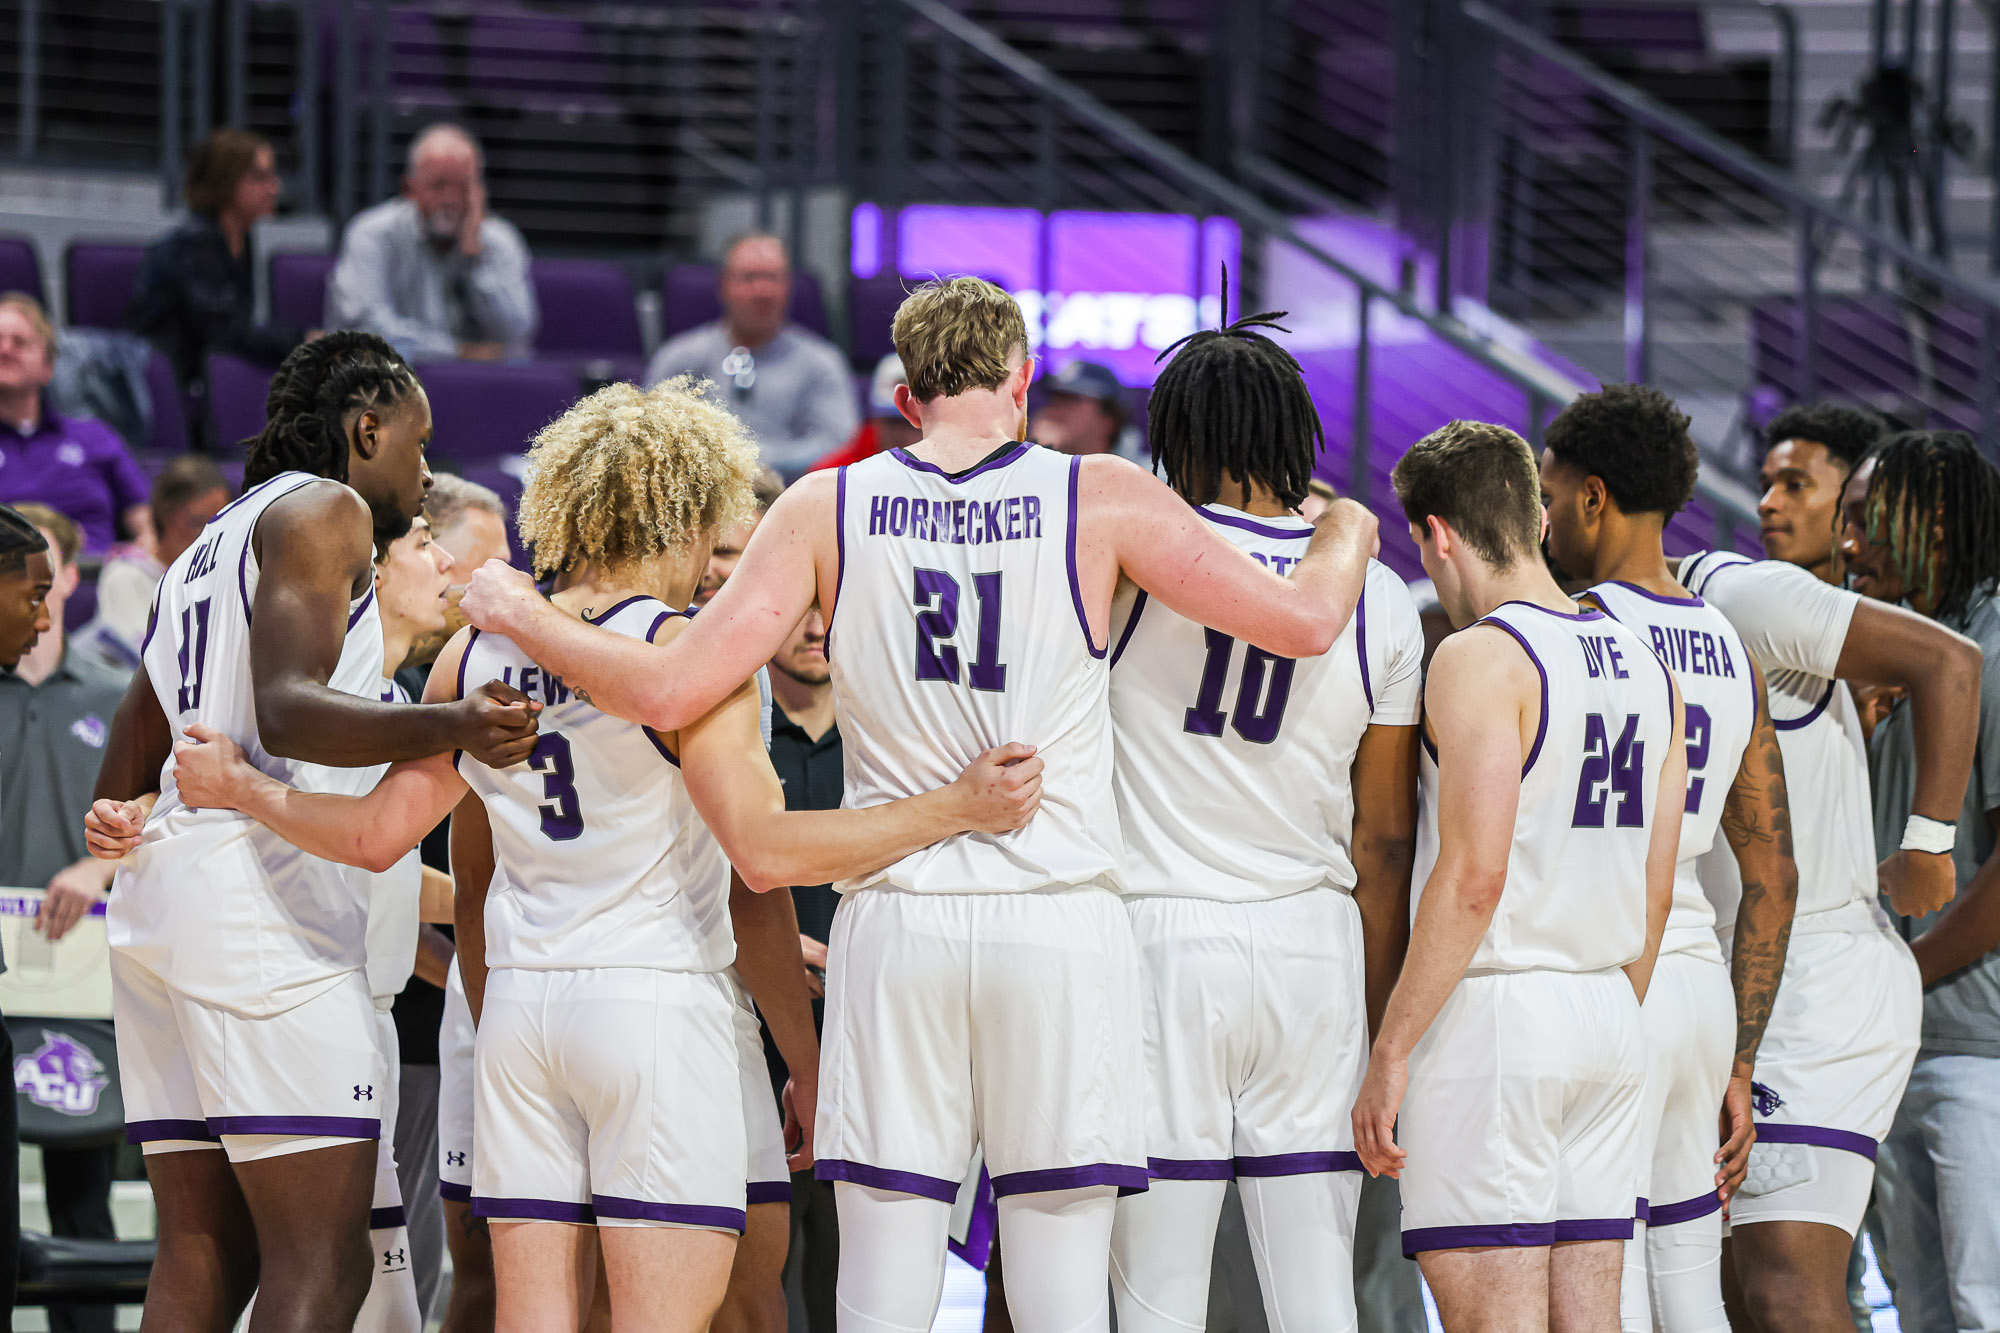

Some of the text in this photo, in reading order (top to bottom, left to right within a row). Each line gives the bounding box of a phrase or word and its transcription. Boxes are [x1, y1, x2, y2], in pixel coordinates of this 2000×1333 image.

[184, 531, 224, 584] HILL
[869, 495, 1042, 546] HORNECKER
[178, 595, 211, 715] 11
[913, 566, 1007, 693] 21
[1575, 634, 1630, 680] DYE
[1648, 624, 1736, 679] RIVERA
[503, 666, 581, 706] LEW
[1183, 625, 1297, 744] 10
[527, 731, 584, 841] 3
[1571, 713, 1645, 828] 24
[1684, 703, 1712, 815] 2
[16, 1059, 97, 1111] ACU
